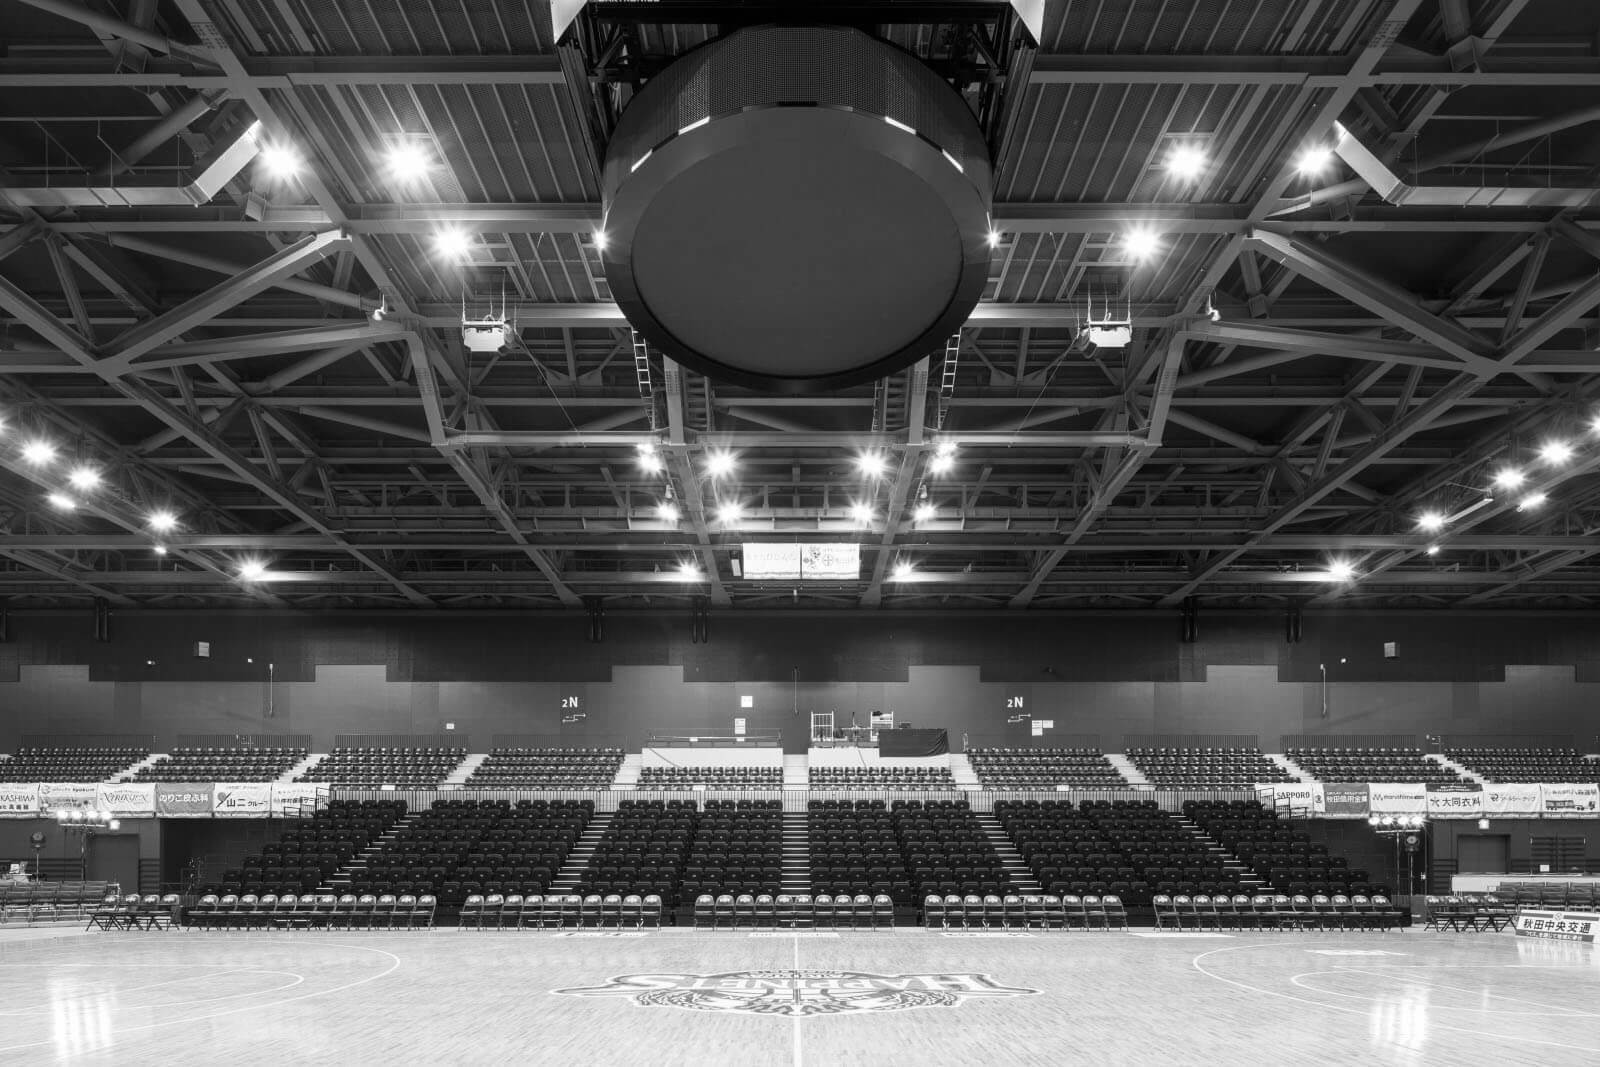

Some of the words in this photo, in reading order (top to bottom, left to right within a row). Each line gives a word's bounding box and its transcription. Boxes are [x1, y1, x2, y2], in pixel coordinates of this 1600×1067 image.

[1276, 791, 1310, 799] SAPPORO
[1523, 918, 1592, 934] 秋田中央交通
